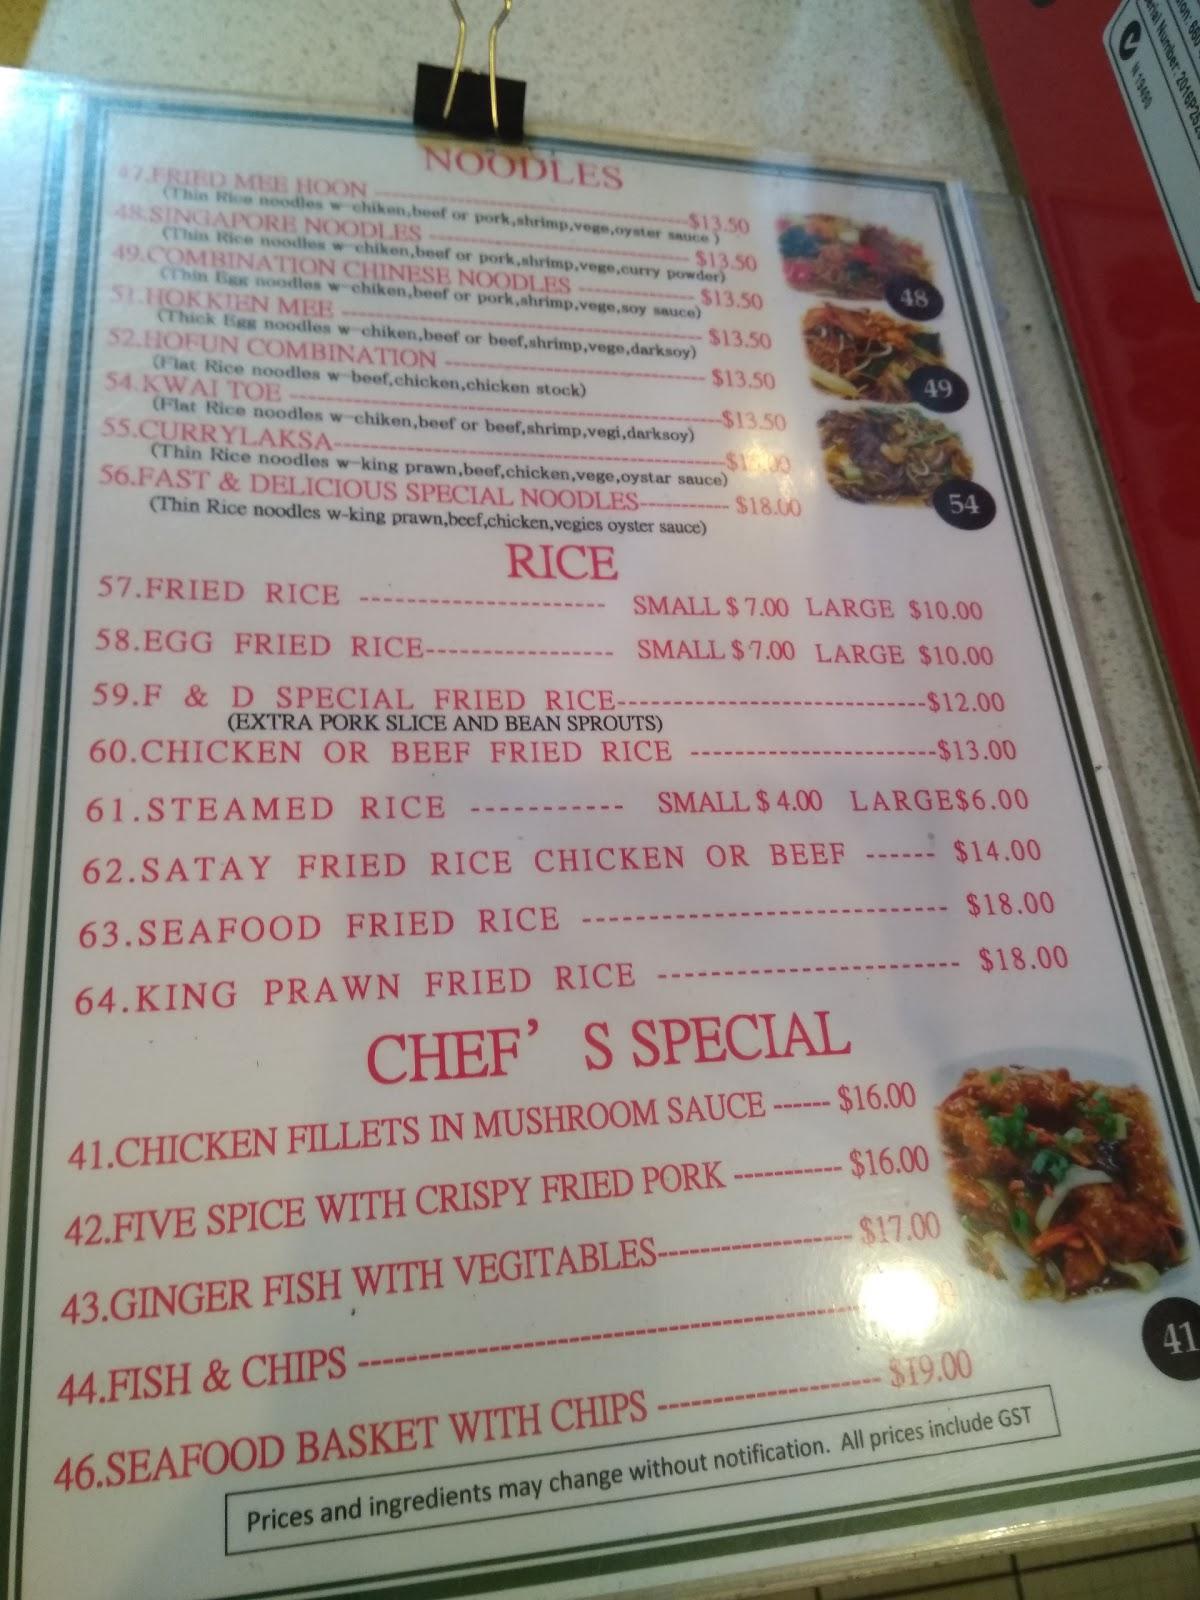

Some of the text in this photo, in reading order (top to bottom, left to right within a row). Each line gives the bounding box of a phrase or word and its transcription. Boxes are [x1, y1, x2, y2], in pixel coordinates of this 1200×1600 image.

[423, 146, 624, 190] NOODLES
[688, 213, 749, 234] $13.50
[305, 217, 421, 242] NOODLES
[695, 251, 757, 272] $13.50
[344, 261, 451, 286] CHINESE
[459, 269, 571, 294] NOODLES
[701, 288, 763, 310] $13.50
[900, 288, 928, 308] 48
[223, 313, 257, 331] Egg
[264, 316, 331, 335] noodles
[709, 328, 772, 350] $13.50
[205, 359, 244, 376] Rice
[252, 362, 320, 381] noodles
[247, 337, 437, 368] COMBINATION
[712, 368, 775, 390] $13.50
[227, 380, 282, 401] TOE
[722, 410, 786, 431] $13.50
[924, 380, 952, 398] 49
[206, 401, 245, 417] Rice
[254, 405, 323, 422] noodles
[210, 445, 251, 463] Rice
[259, 449, 329, 468] noodles
[219, 471, 241, 492] &
[251, 473, 397, 501] DELICIOUS
[406, 482, 513, 506] SPECIAL
[521, 488, 639, 511] NOODLES
[949, 494, 980, 514] 54
[207, 498, 247, 516] Rice
[254, 503, 321, 520] noodles
[608, 518, 654, 535] oyster
[507, 543, 618, 580] RICE
[266, 582, 340, 605] RICE
[633, 595, 720, 616] SMALL
[806, 597, 895, 618] LARGE
[909, 599, 983, 621] $10.00
[234, 633, 331, 656] FRIED
[351, 636, 424, 658] RICE
[638, 639, 726, 660] SMALL
[815, 643, 905, 665] LARGE
[919, 645, 994, 667] $10.00
[184, 684, 209, 708] &
[231, 685, 254, 708] D
[276, 686, 414, 711] SPECIAL
[434, 689, 526, 711] FRIED
[545, 690, 615, 711] RICE
[927, 691, 1006, 714] $12.00
[320, 714, 379, 732] PORK
[386, 715, 447, 732] SLICE
[453, 715, 499, 732] AND
[505, 715, 561, 732] BEAN
[323, 741, 369, 763] OR
[392, 741, 470, 763] BEEF
[491, 741, 582, 763] FRIED
[602, 740, 672, 762] RICE
[938, 738, 1017, 762] $13.00
[360, 795, 446, 819] RICE
[658, 791, 750, 813] SMALL
[298, 853, 406, 880] FRIED
[431, 850, 512, 876] RICE
[535, 846, 685, 873] CHICKEN
[706, 844, 749, 867] OR
[770, 842, 846, 866] BEEF
[954, 838, 1041, 864] $14.00
[347, 910, 455, 938] FRIED
[479, 906, 560, 933] RICE
[967, 891, 1055, 918] $18.00
[264, 973, 400, 1006] PRAWN
[425, 967, 532, 998] FRIED
[556, 962, 636, 991] RICE
[979, 944, 1068, 973] $18.00
[632, 1010, 851, 1069] SPECIAL
[287, 1115, 420, 1155] FILLETS
[429, 1112, 465, 1143] IN
[474, 1098, 659, 1139] MUSHROOM
[669, 1091, 766, 1124] SAUCE
[838, 1080, 916, 1113] $16.00
[207, 1198, 305, 1237] SPICE
[316, 1188, 406, 1225] WITH
[415, 1176, 530, 1216] CRISPY
[542, 1169, 634, 1203] FRIED
[643, 1160, 727, 1195] PORK
[850, 1145, 930, 1180] $16.00
[262, 1269, 341, 1308] FISH
[352, 1258, 443, 1297] WITH
[454, 1237, 658, 1286] VEGITABLES
[860, 1211, 940, 1246] $17.00
[1163, 1322, 1199, 1355] 41
[202, 1359, 231, 1393] &
[242, 1346, 347, 1388] CHIPS
[296, 1416, 438, 1465] BASKET
[449, 1403, 542, 1444] WITH
[550, 1390, 647, 1433] CHIPS
[247, 1405, 1032, 1532] Prices and ingredients may change without notification. All prices include GST
